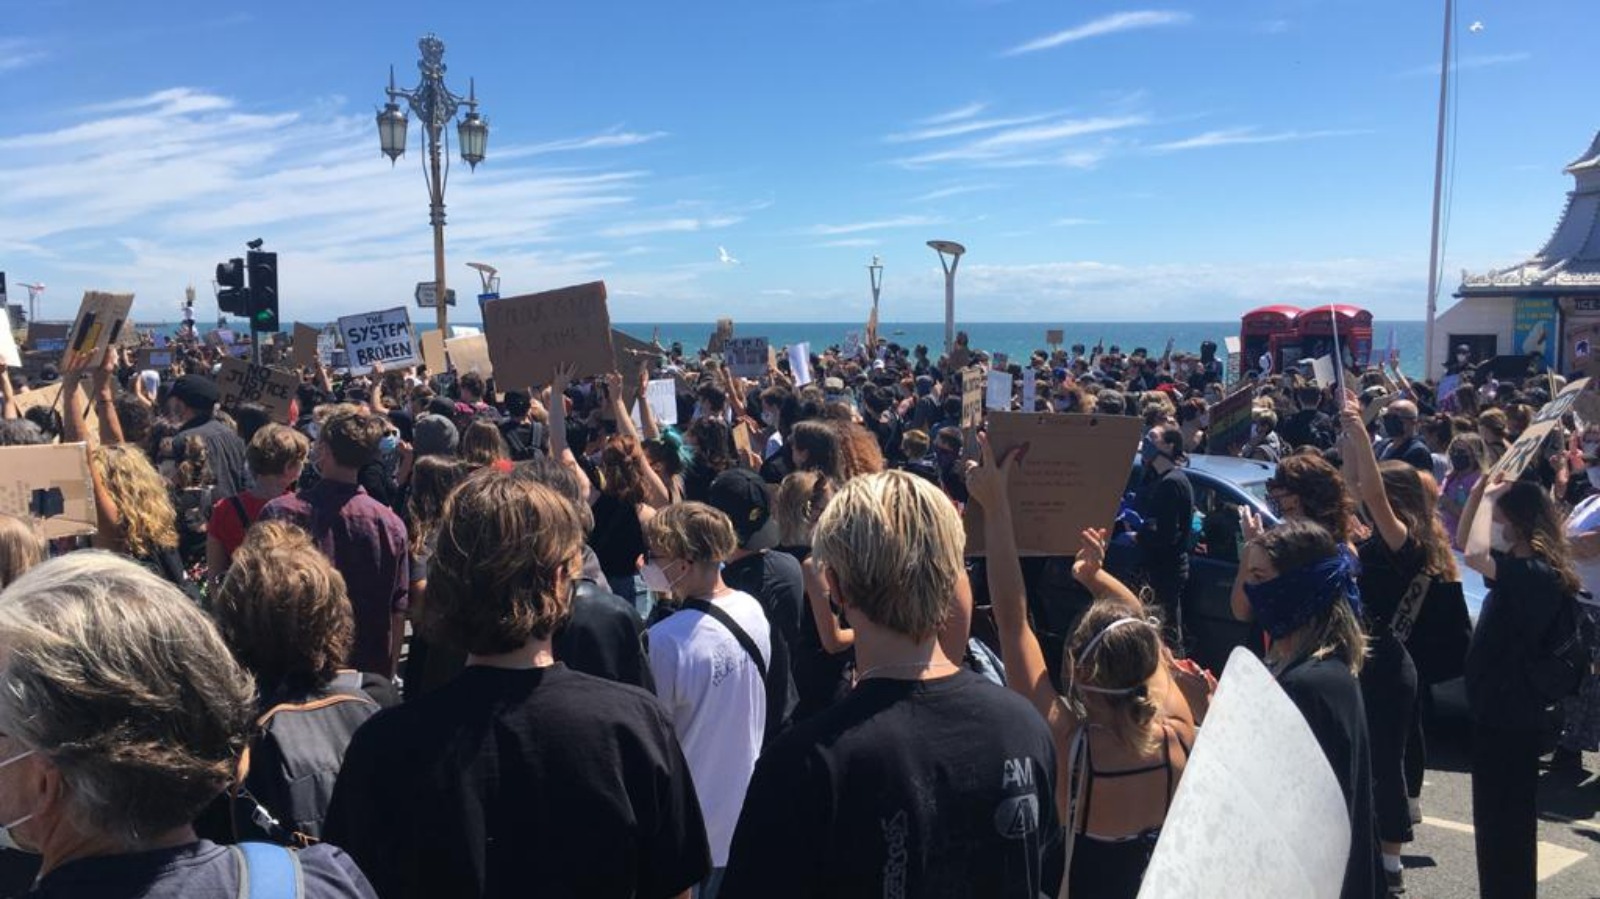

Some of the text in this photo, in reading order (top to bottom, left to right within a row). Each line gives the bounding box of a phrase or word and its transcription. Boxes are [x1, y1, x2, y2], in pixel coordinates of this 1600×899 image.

[366, 314, 383, 324] THE
[348, 322, 409, 344] SYSTEM
[356, 342, 412, 366] BROKEN
[248, 363, 270, 379] NO
[226, 368, 290, 399] JUSTICE
[240, 386, 261, 401] NO
